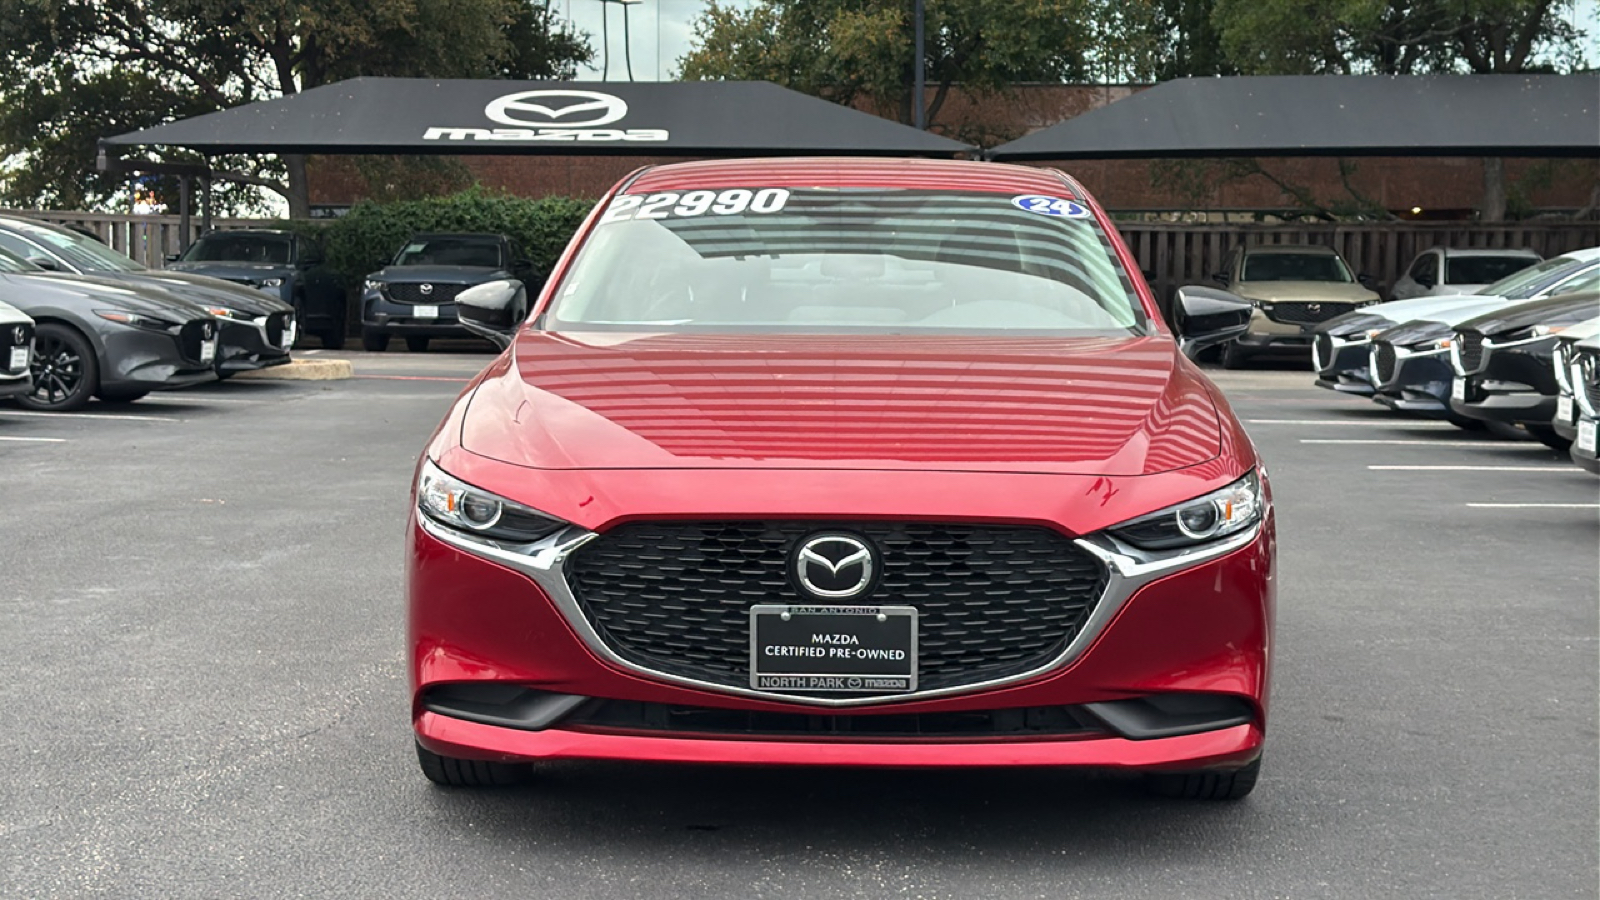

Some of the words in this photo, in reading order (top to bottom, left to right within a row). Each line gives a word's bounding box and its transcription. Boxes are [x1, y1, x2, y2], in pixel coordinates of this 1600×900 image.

[422, 126, 669, 141] mazda
[603, 188, 790, 221] 22990
[1029, 198, 1072, 215] 24
[811, 634, 859, 645] MAZDA
[765, 646, 825, 657] CERTIFIED
[829, 648, 905, 660] PRE-OWNED
[760, 677, 806, 687] NORTH
[810, 678, 844, 688] PARK
[865, 679, 906, 688] mazda
